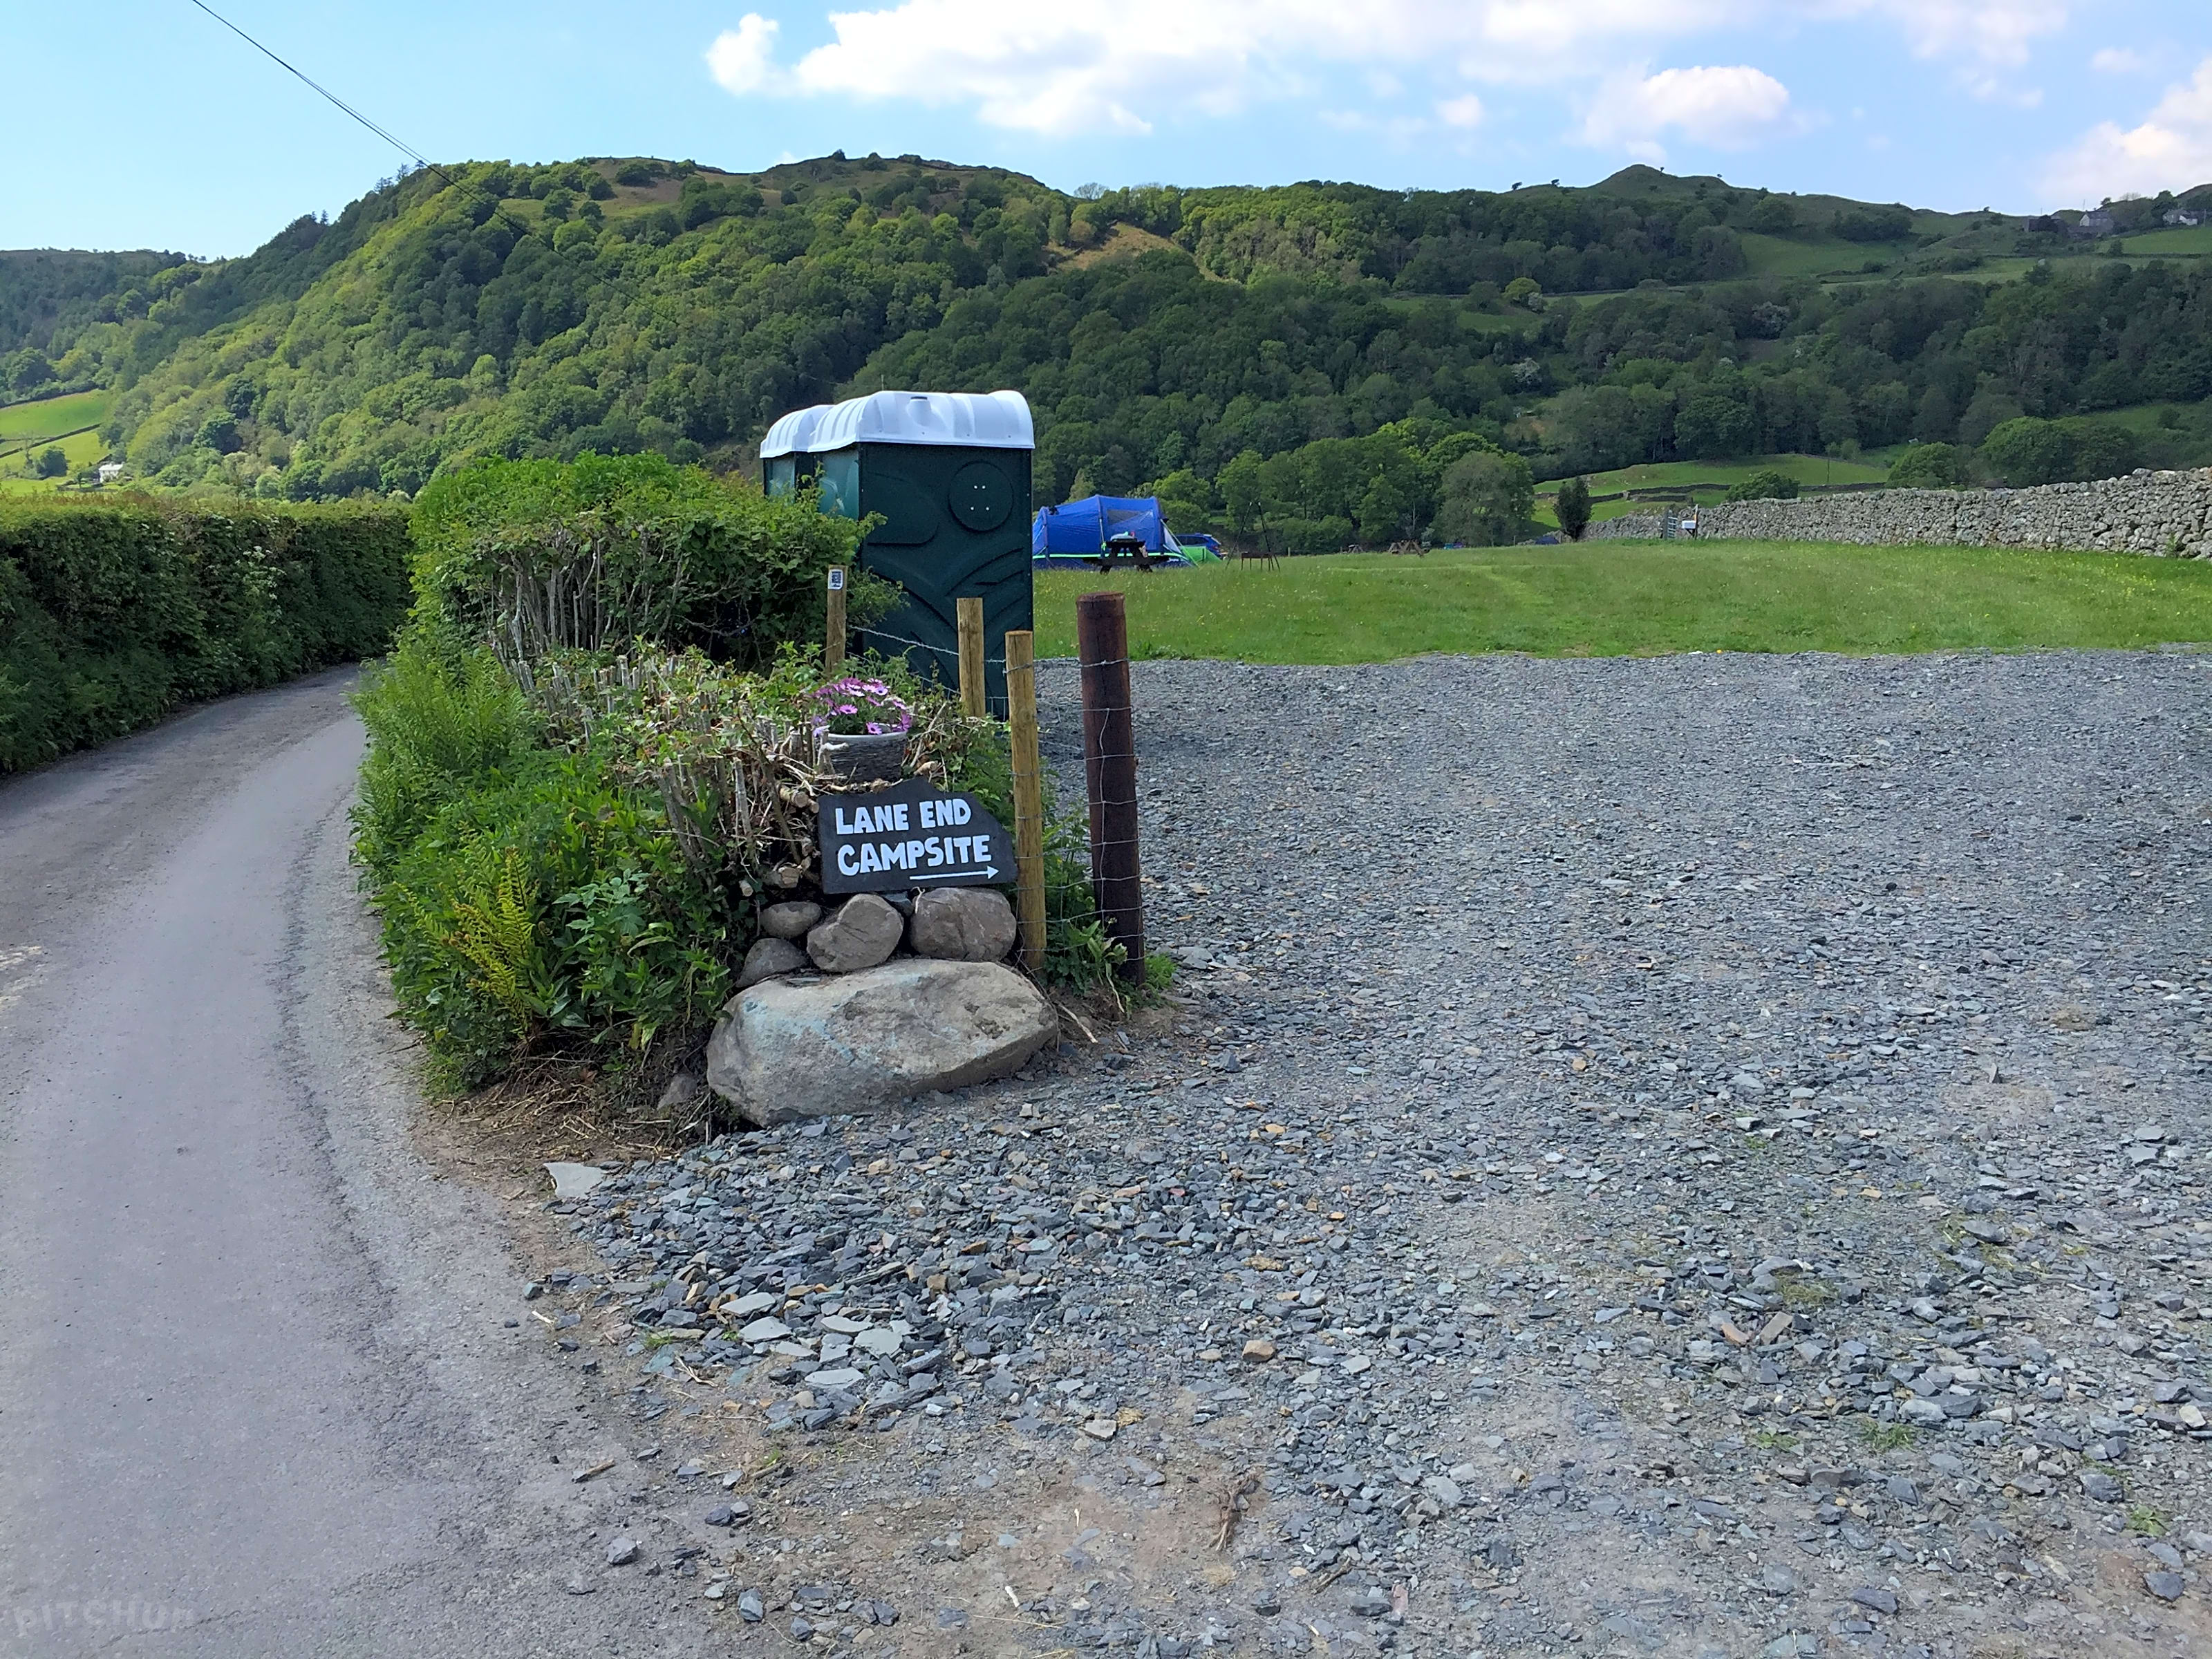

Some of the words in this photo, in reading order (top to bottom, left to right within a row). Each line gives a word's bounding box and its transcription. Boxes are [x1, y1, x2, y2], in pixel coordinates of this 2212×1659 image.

[835, 803, 909, 835] LANE
[919, 798, 971, 829] END
[837, 834, 992, 877] CAMPSITE
